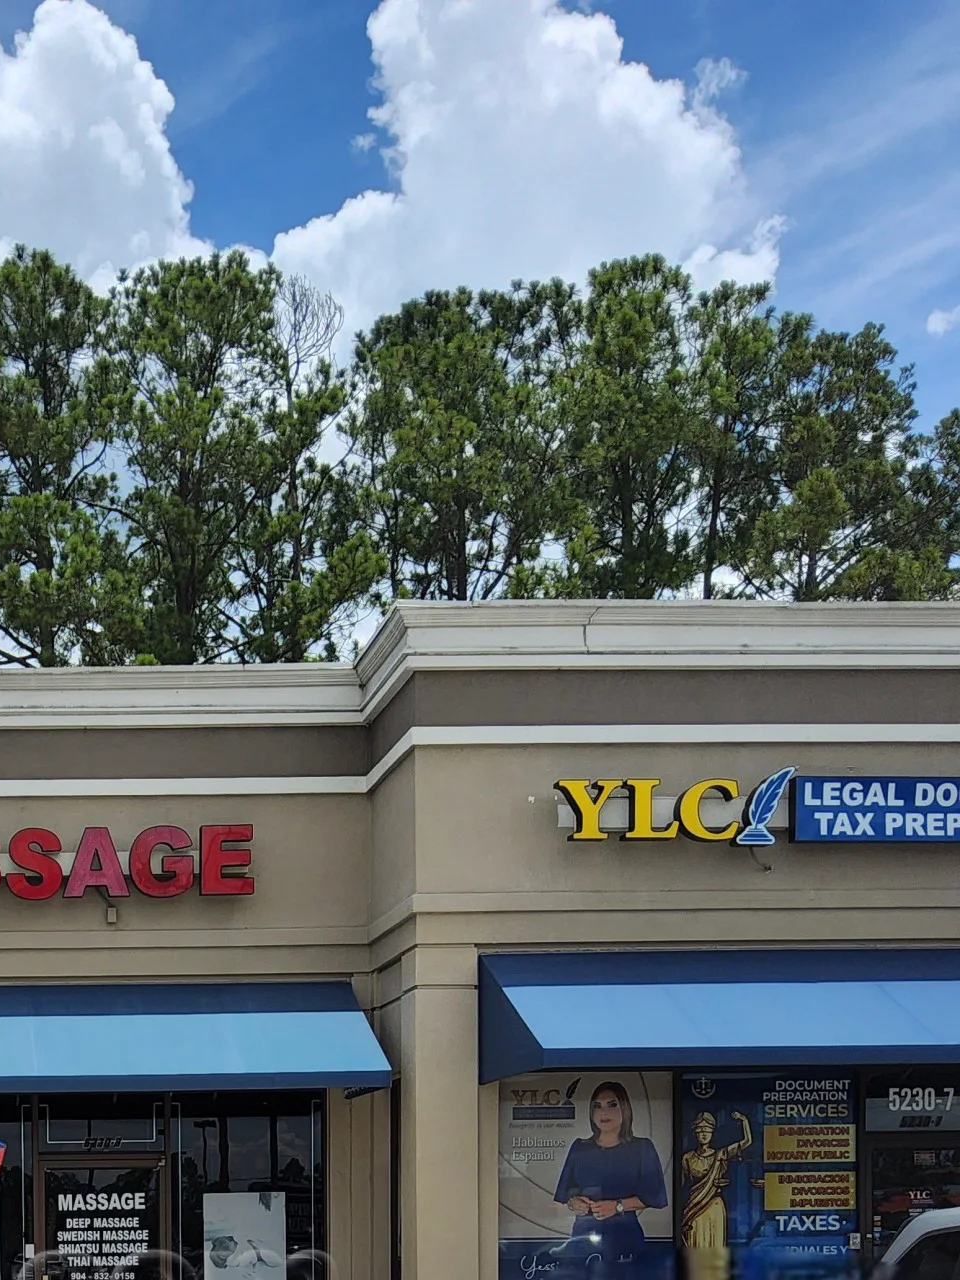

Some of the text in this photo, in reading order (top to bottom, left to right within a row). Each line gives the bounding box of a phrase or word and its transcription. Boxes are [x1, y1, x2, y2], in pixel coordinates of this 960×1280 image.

[804, 782, 960, 807] LEGAL DO
[554, 778, 740, 841] YLC
[814, 812, 876, 836] TAX
[775, 1080, 851, 1091] DOCUMENT
[511, 1089, 561, 1106] YLC
[763, 1091, 848, 1102] PREPARATION
[888, 1087, 955, 1111] 5230-7
[764, 1104, 849, 1118] SERVICES
[778, 1127, 850, 1136] IMMIGRATION
[512, 1137, 566, 1148] Hablamos
[796, 1139, 850, 1148] DIVORCES
[512, 1151, 555, 1164] Español
[767, 1150, 850, 1160] NOTARY PUBLIC
[792, 1186, 850, 1196] DIVORCIOS
[908, 1191, 931, 1199] YLC
[58, 1193, 146, 1211] MASSAGE
[790, 1198, 850, 1208] IMPUESTOS
[66, 1217, 140, 1229] DEEP MASSAGE
[774, 1215, 841, 1231] TAXES
[57, 1230, 150, 1242] SWEDISH MASSAGE
[58, 1243, 148, 1255] SHIATSU MASSAGE
[67, 1255, 140, 1267] THAI MASSAGE
[70, 1272, 87, 1280] 904
[114, 1272, 135, 1280] 0158
